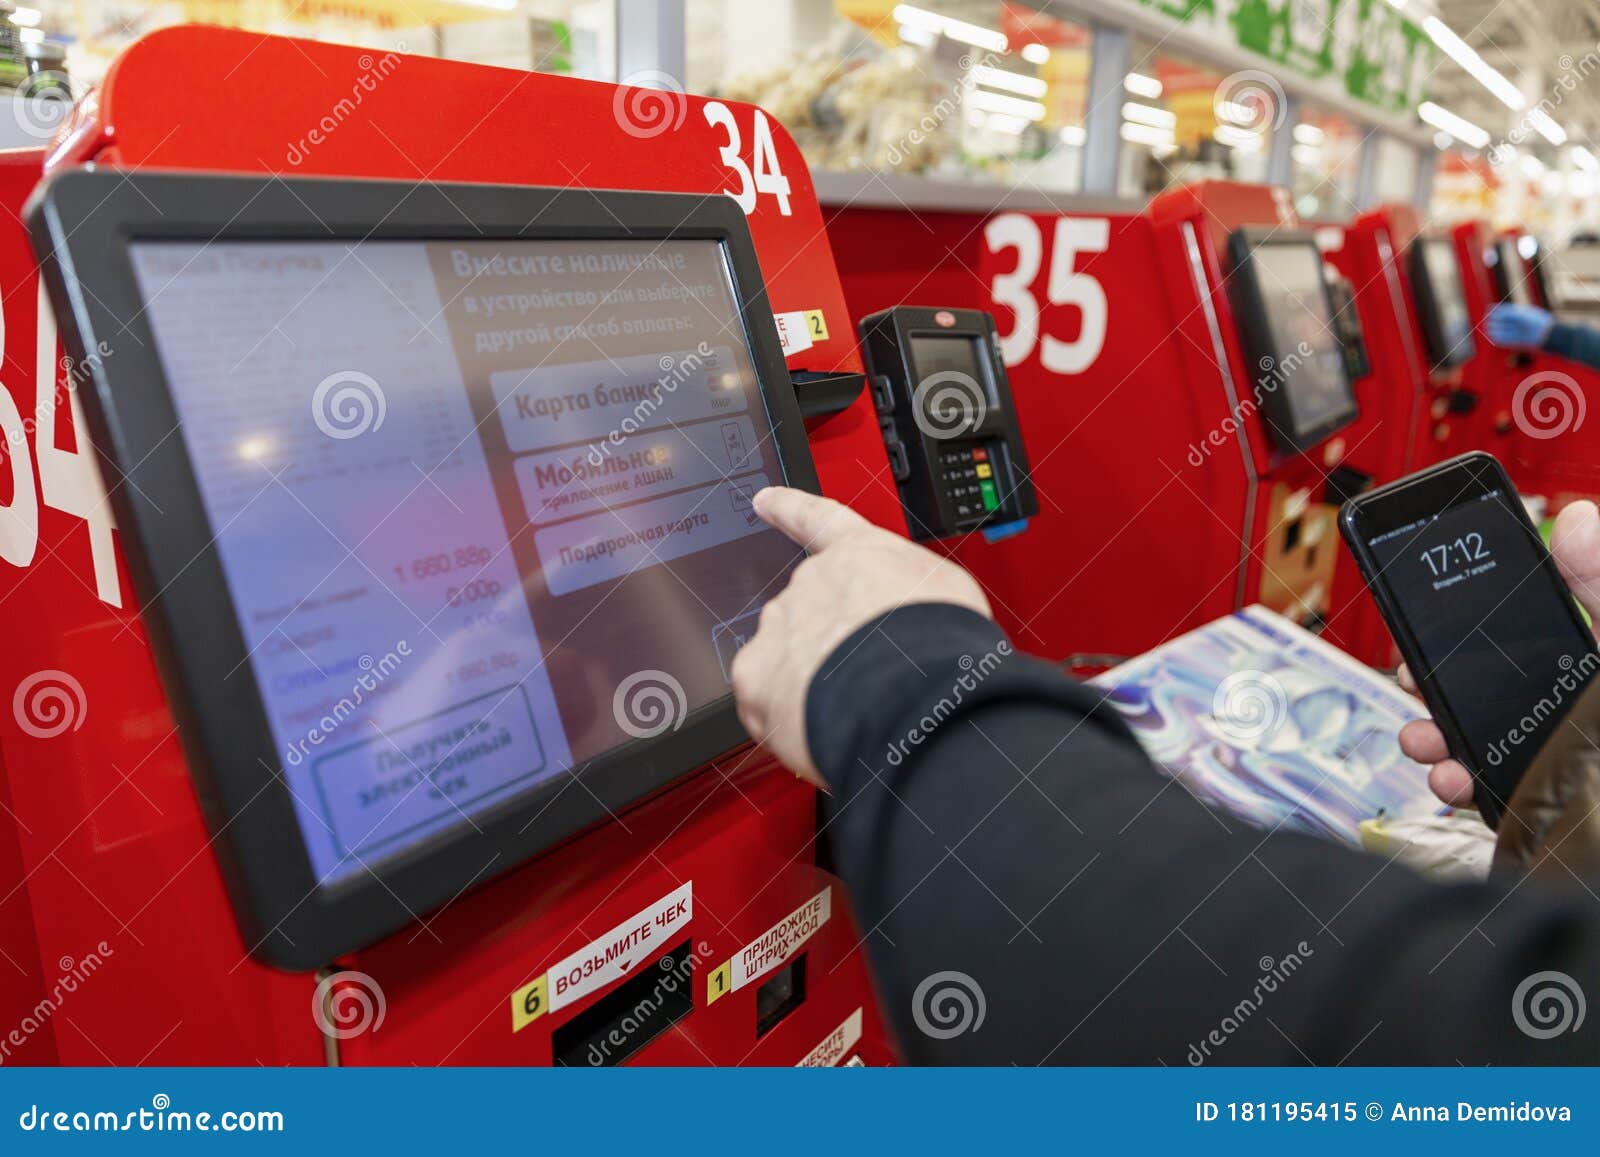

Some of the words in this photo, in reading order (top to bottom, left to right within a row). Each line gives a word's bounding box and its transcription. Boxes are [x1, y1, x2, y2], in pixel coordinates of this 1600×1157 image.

[703, 101, 793, 216] 34
[451, 248, 566, 278] Внесите
[568, 251, 688, 275] наличные
[464, 296, 478, 314] в
[482, 287, 597, 318] устройство
[600, 290, 635, 305] или
[638, 282, 716, 306] выберите
[984, 213, 1111, 375] 35
[475, 322, 549, 353] другой
[553, 316, 619, 342] способ
[811, 315, 823, 335] 2
[514, 389, 593, 421] Карта
[594, 381, 662, 411] банка
[534, 446, 671, 490] Мобильное
[542, 479, 630, 512] приложение
[634, 467, 674, 489] АШАН
[559, 521, 666, 566] Подарочная
[667, 511, 710, 537] карта
[1420, 532, 1491, 577] 17:12
[556, 921, 651, 996] ВОЗЬМИТЕ
[656, 899, 688, 928] ЧЕК
[743, 897, 821, 965] ПРИЛОЖИТЕ
[747, 915, 819, 979] ШТРИХ-КОД
[524, 987, 540, 1015] 6
[715, 970, 724, 992] 1
